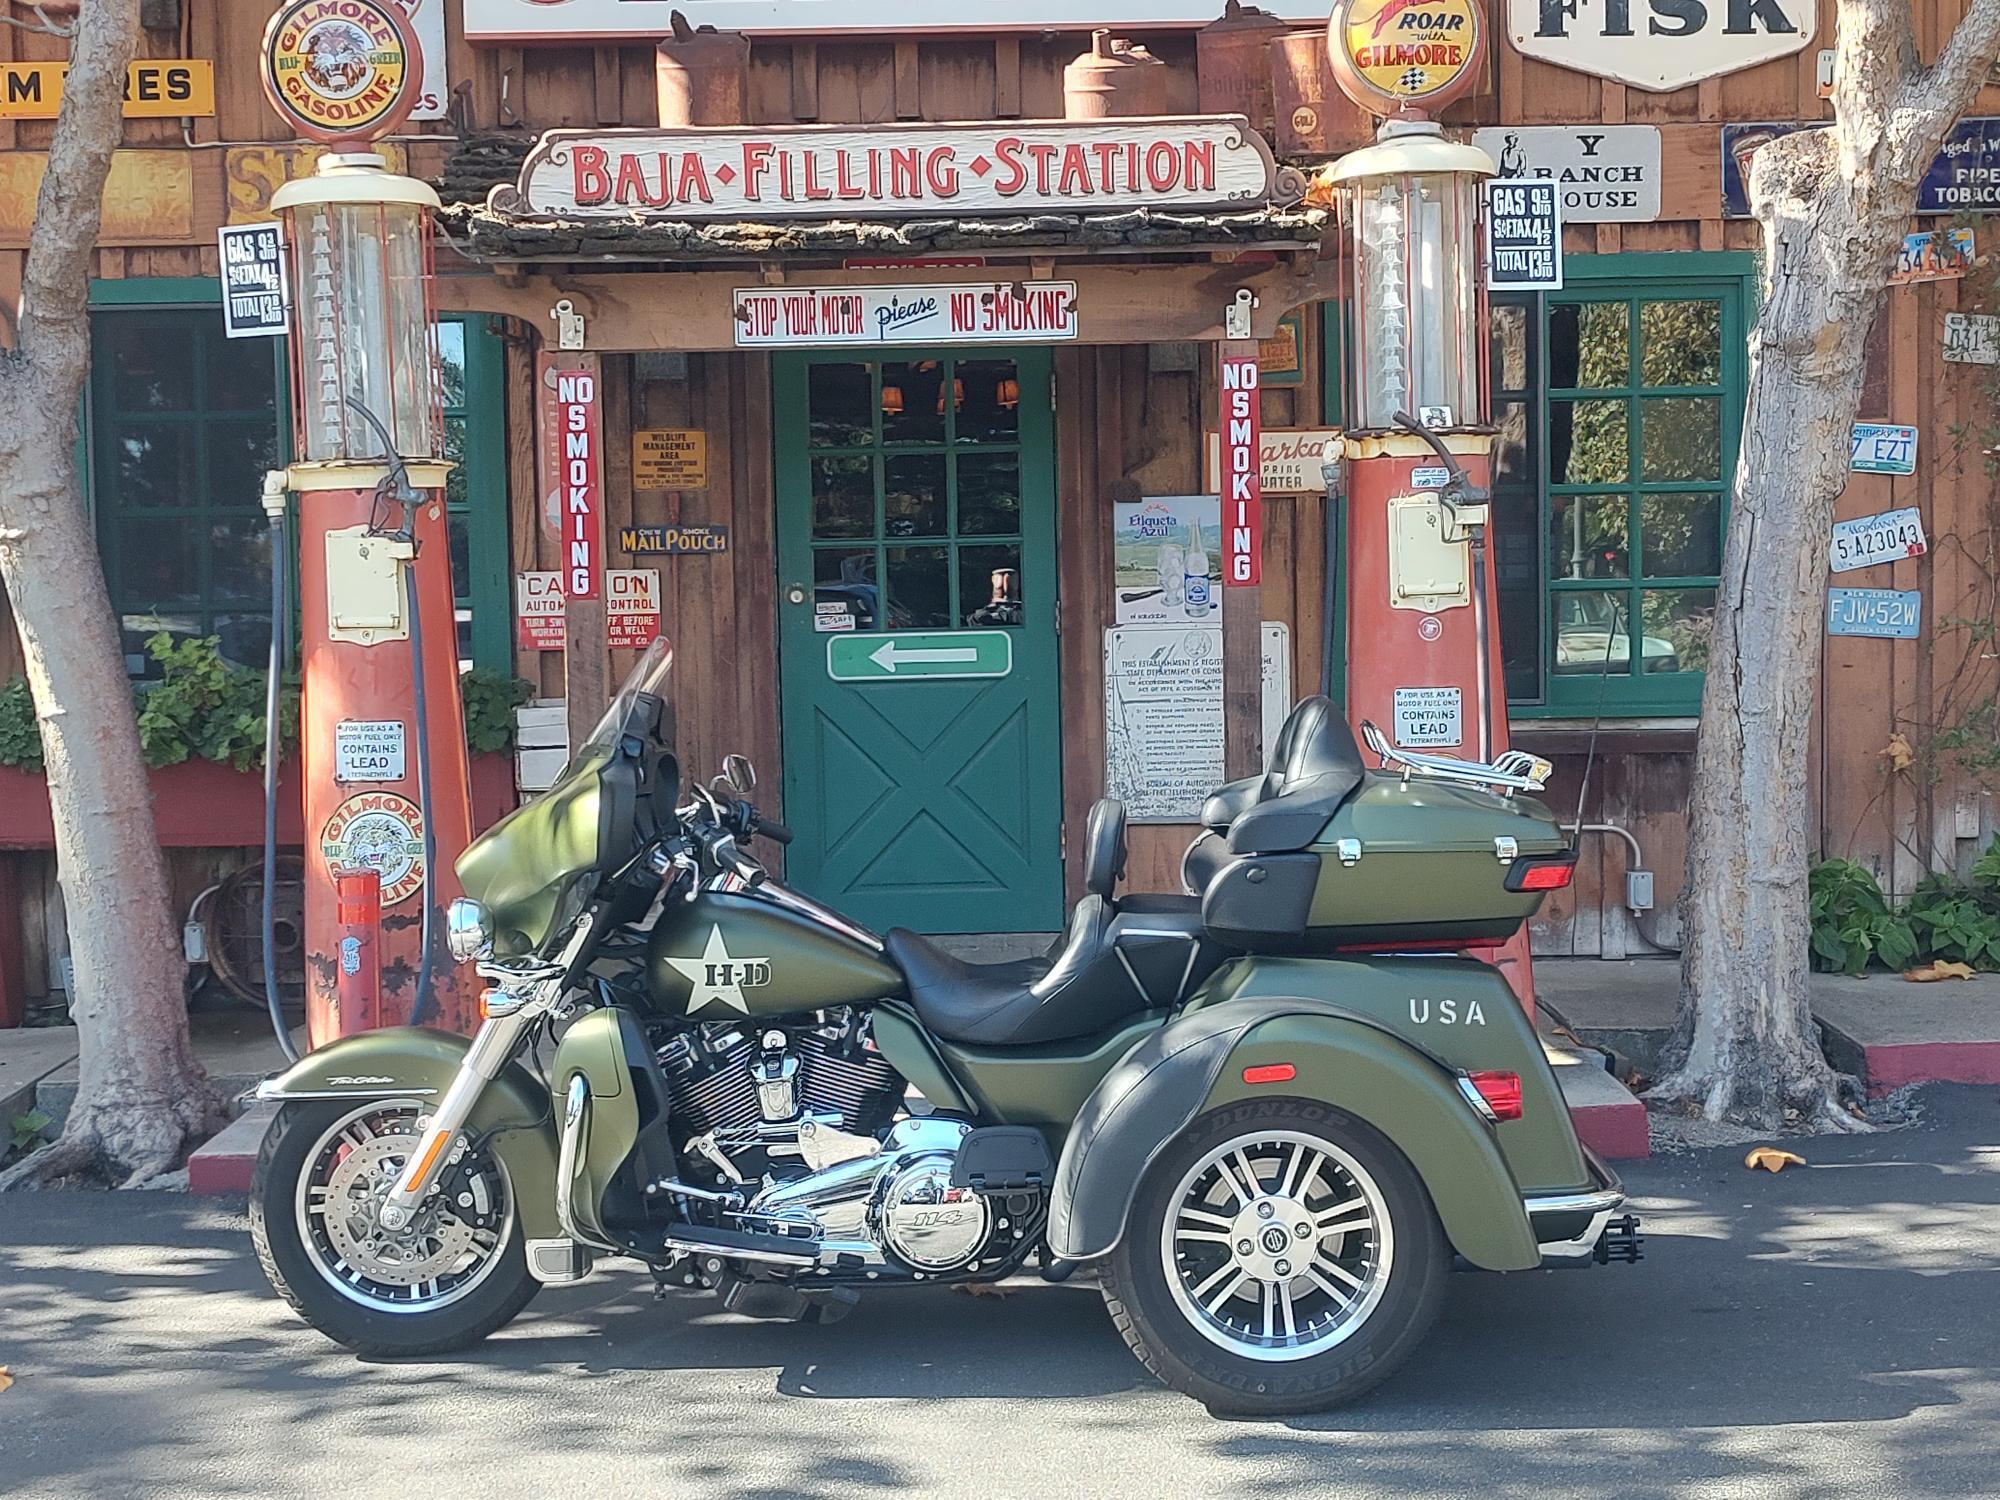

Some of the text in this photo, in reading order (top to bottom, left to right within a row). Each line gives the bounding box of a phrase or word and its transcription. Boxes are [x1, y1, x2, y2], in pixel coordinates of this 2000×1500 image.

[281, 1, 393, 53] GILMORE
[1398, 12, 1464, 31] ROAR
[1533, 0, 1798, 37] FISK
[1410, 29, 1451, 42] with
[1355, 44, 1463, 69] GILMORE
[286, 73, 395, 120] GASOLINE
[1576, 134, 1605, 156] Y
[572, 137, 1217, 209] BAJA FILLING STATION
[1533, 166, 1643, 183] RANCH
[1493, 188, 1526, 216] GAS
[1560, 191, 1637, 208] OUSE
[226, 234, 255, 264] GAS
[1494, 250, 1528, 272] TOTAL
[231, 297, 261, 319] TOTAL
[744, 289, 1068, 342] STOP YOUR MOTOR Please NO SMOKING
[643, 441, 696, 451] MANAGEMENT
[660, 451, 680, 460] AREA
[1874, 439, 1912, 462] EZT
[1223, 362, 1258, 582] NO SMOKING
[558, 375, 594, 597] NO SMOKING
[1129, 513, 1177, 529] Etiqueta
[1848, 518, 1898, 536] MONTANA
[621, 529, 726, 551] MAIL POUCH
[1134, 526, 1169, 540] Azul
[607, 598, 656, 610] ONTROL
[526, 618, 545, 628] TURN
[623, 615, 654, 625] BEFORE
[609, 626, 622, 635] OR
[625, 626, 647, 635] WELL
[1420, 691, 1435, 699] USE
[1401, 709, 1456, 721] CONTAINS
[1410, 722, 1448, 735] LEAD
[342, 743, 398, 754] CONTAINS
[351, 756, 389, 769] LEAD
[705, 963, 770, 987] H-D
[1210, 1101, 1351, 1131] DUNLOP
[913, 1209, 963, 1227] 114
